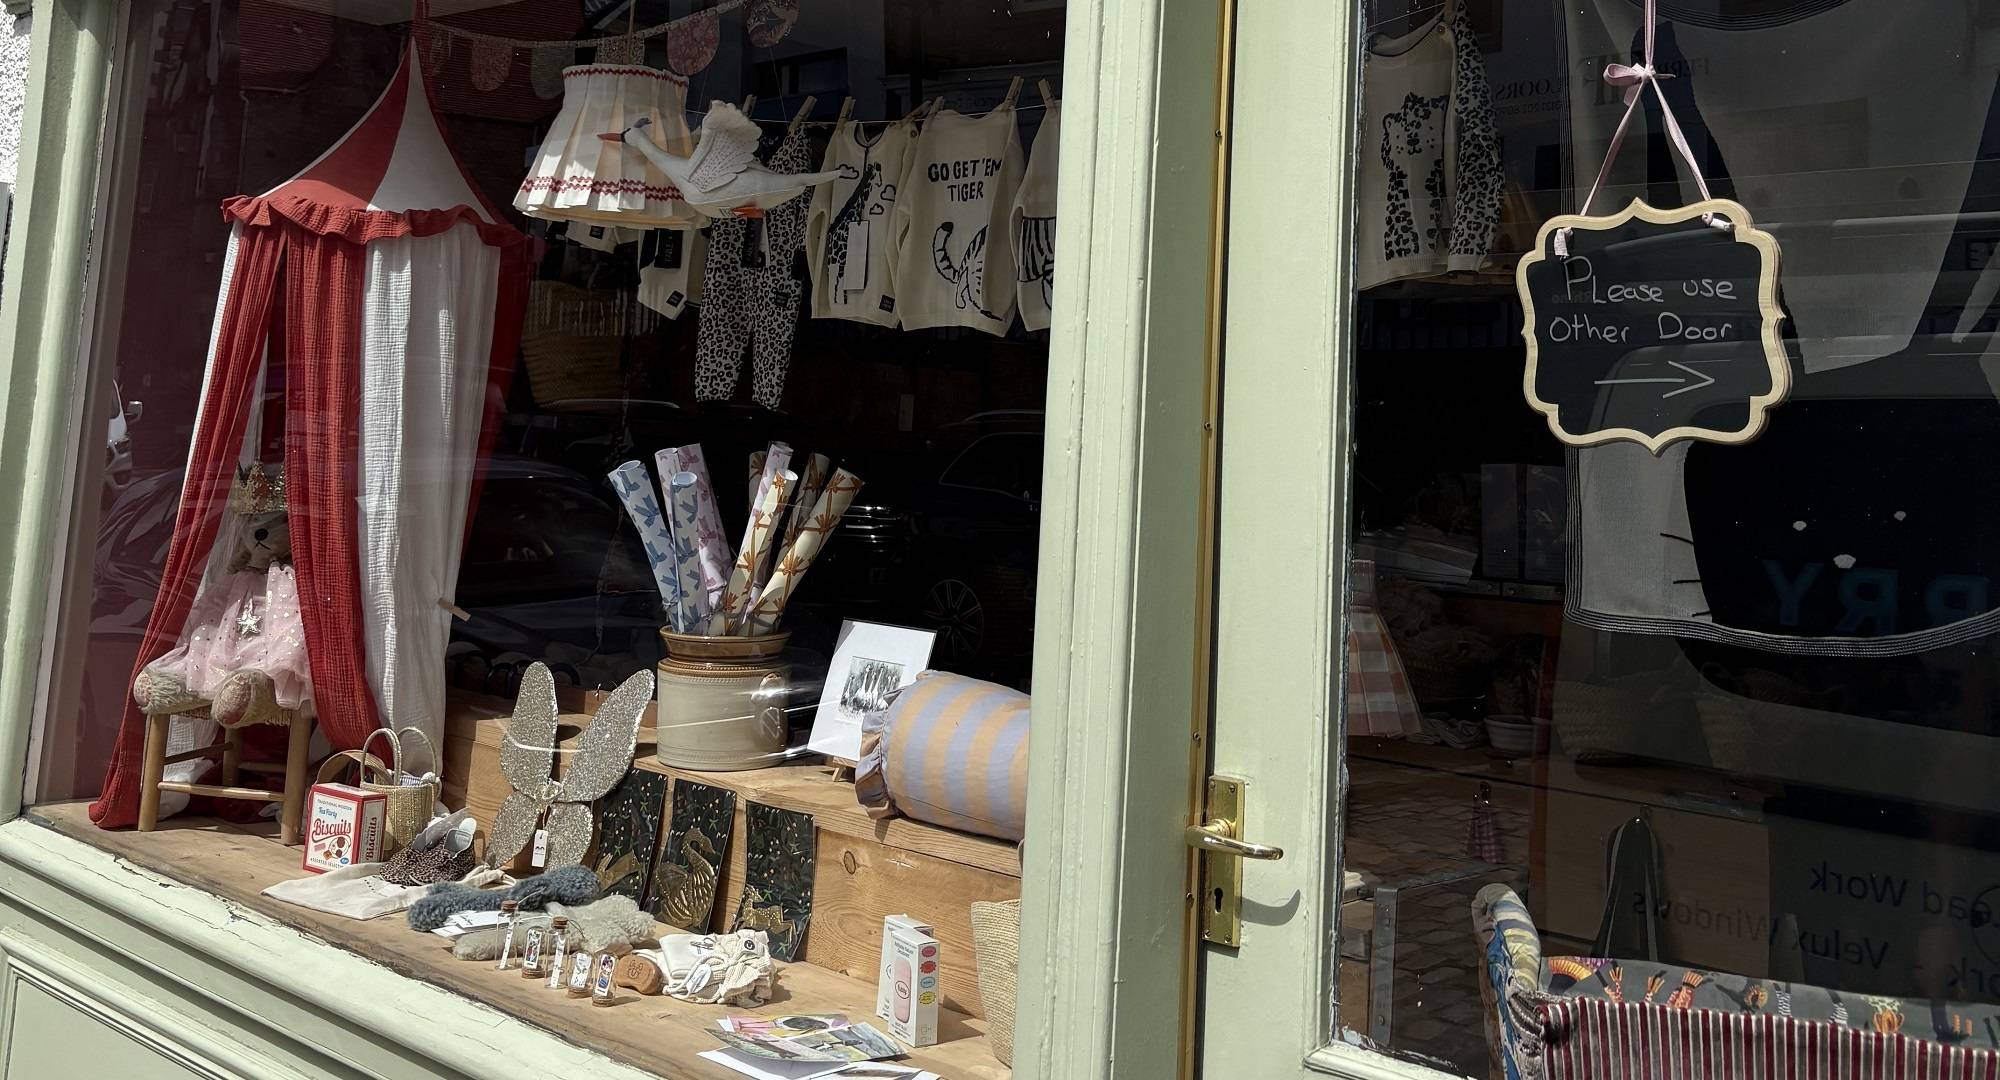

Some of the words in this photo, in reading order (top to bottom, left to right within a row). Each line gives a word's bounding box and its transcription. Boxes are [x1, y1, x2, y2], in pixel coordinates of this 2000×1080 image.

[928, 163, 949, 182] GO
[953, 160, 980, 179] GET
[982, 157, 1002, 176] 'EM
[947, 181, 984, 202] TIGER
[1682, 278, 1737, 300] use
[1549, 313, 1630, 343] Other
[1657, 311, 1732, 340] Door
[313, 818, 352, 837] Biscuits
[365, 816, 377, 861] Biscuits
